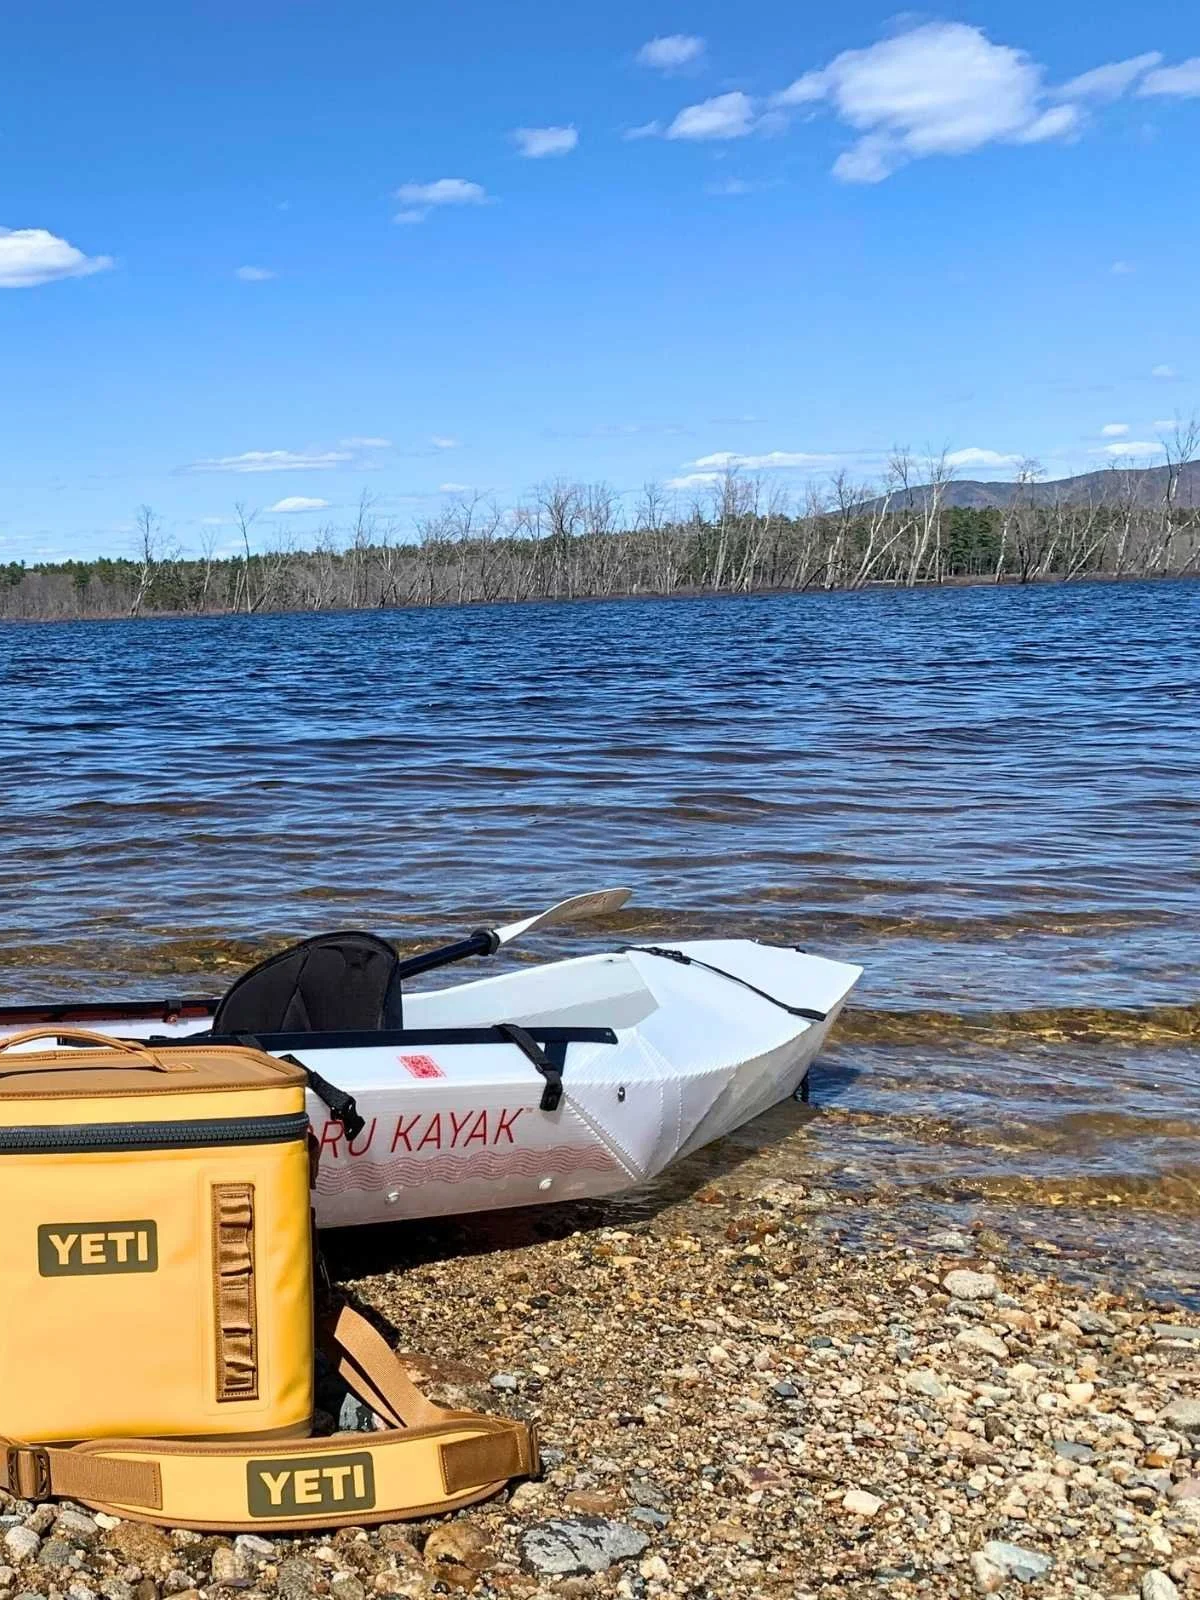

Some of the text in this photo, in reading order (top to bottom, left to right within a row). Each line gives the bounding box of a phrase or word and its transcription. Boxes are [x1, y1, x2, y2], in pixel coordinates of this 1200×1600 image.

[308, 1107, 525, 1159] RU KAYAK
[48, 1231, 148, 1265] YETI
[259, 1464, 366, 1505] YETI
